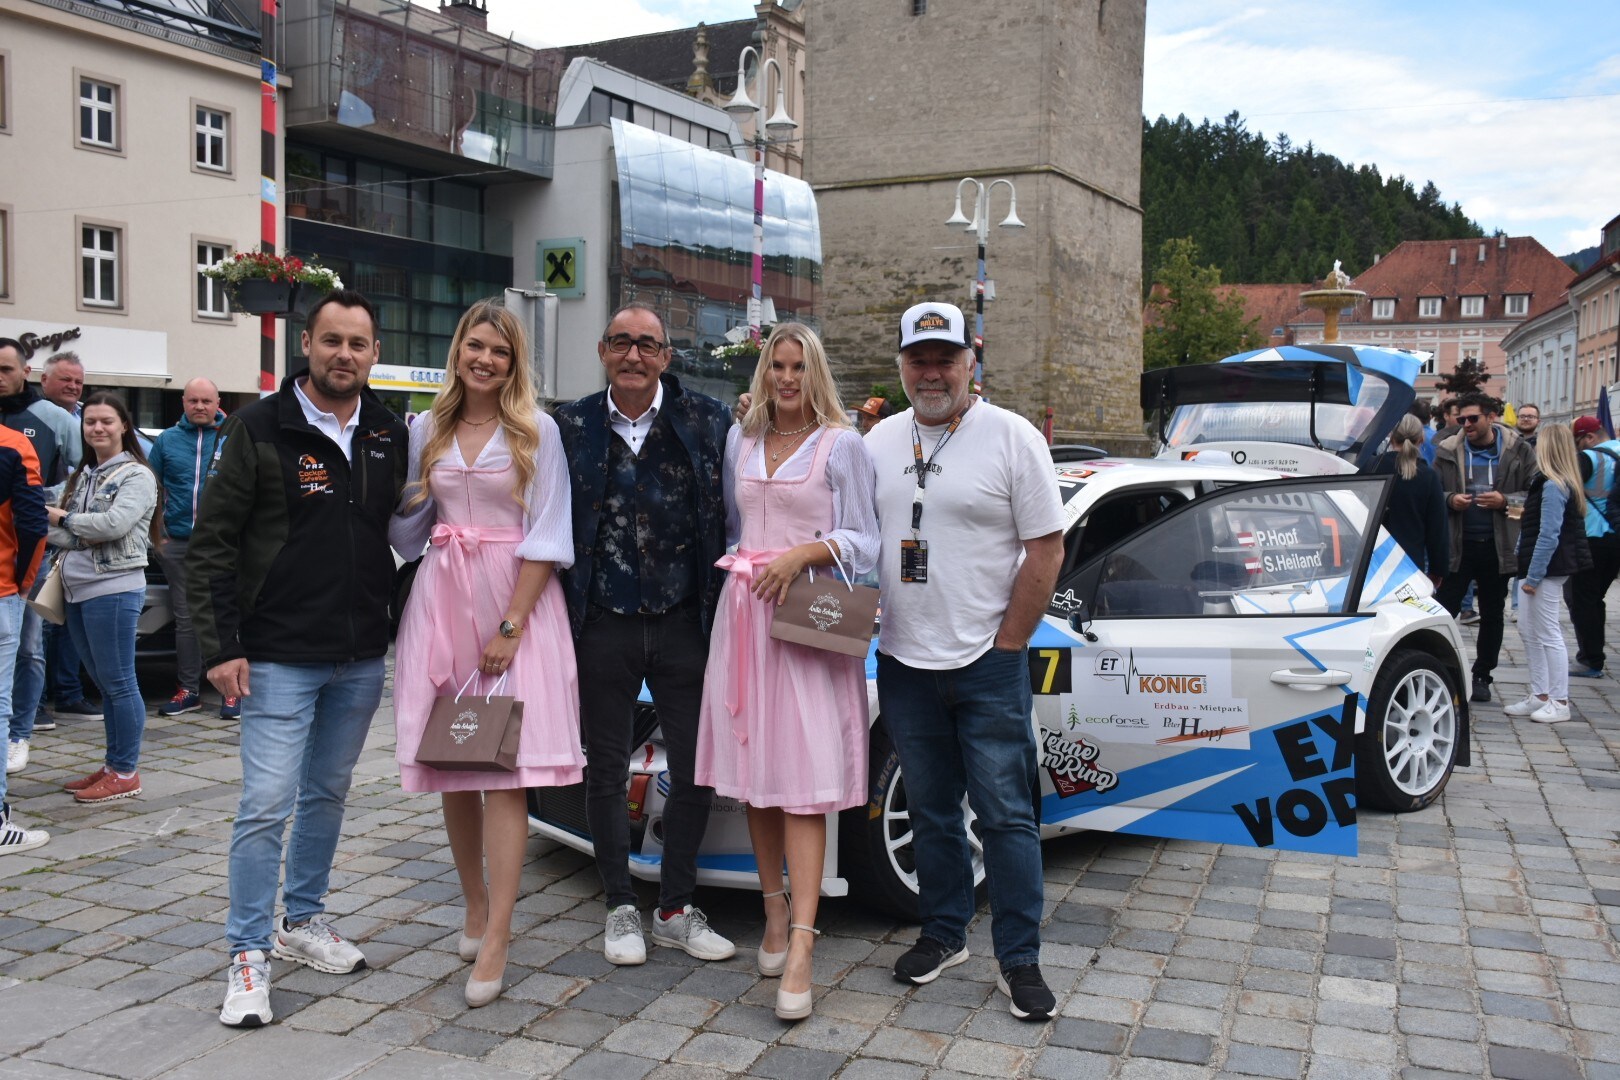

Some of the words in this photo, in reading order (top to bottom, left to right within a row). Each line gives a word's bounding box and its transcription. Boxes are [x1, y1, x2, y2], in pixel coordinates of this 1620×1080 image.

[919, 319, 944, 327] RALLYE
[20, 327, 81, 360] Sorger
[298, 469, 327, 478] Cockpit
[1256, 528, 1298, 547] P.Hopf
[1264, 551, 1322, 573] S.Heiland
[1039, 650, 1060, 693] 7
[1100, 658, 1118, 671] ET
[1139, 674, 1202, 694] KÖNIG
[1153, 702, 1189, 711] Erdbau
[1199, 704, 1243, 713] Mietpark
[1085, 714, 1150, 726] ecoforst
[1162, 716, 1182, 729] Peter
[1178, 717, 1226, 742] Hopf
